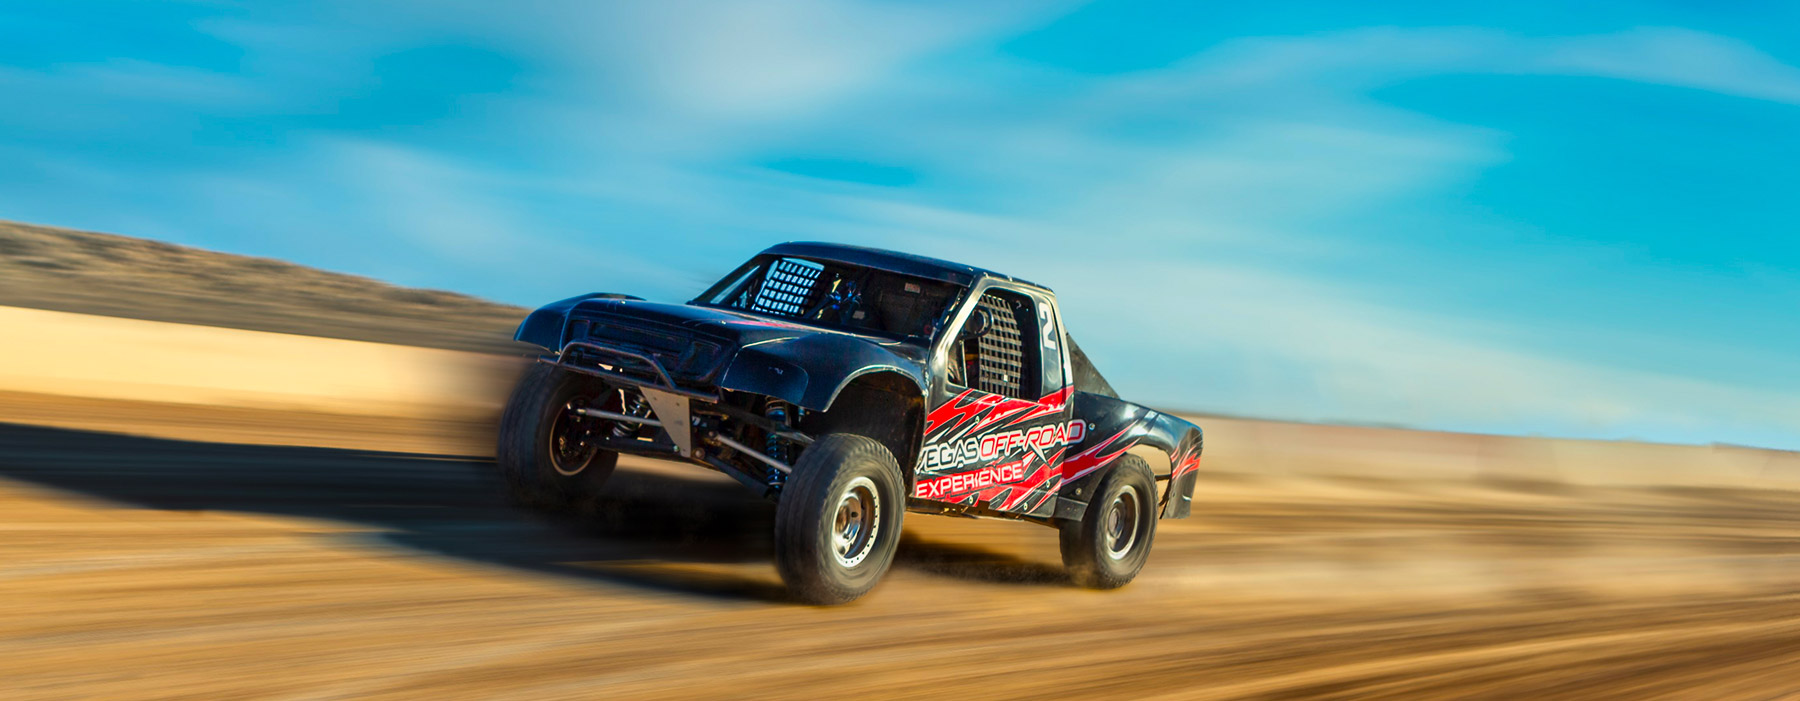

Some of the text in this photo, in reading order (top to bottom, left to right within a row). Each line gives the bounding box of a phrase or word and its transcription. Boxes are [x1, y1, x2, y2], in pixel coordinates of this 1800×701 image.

[1039, 302, 1056, 350] 2
[979, 419, 1086, 462] OFF-ROAD
[916, 464, 1023, 498] EXPERIENCE
